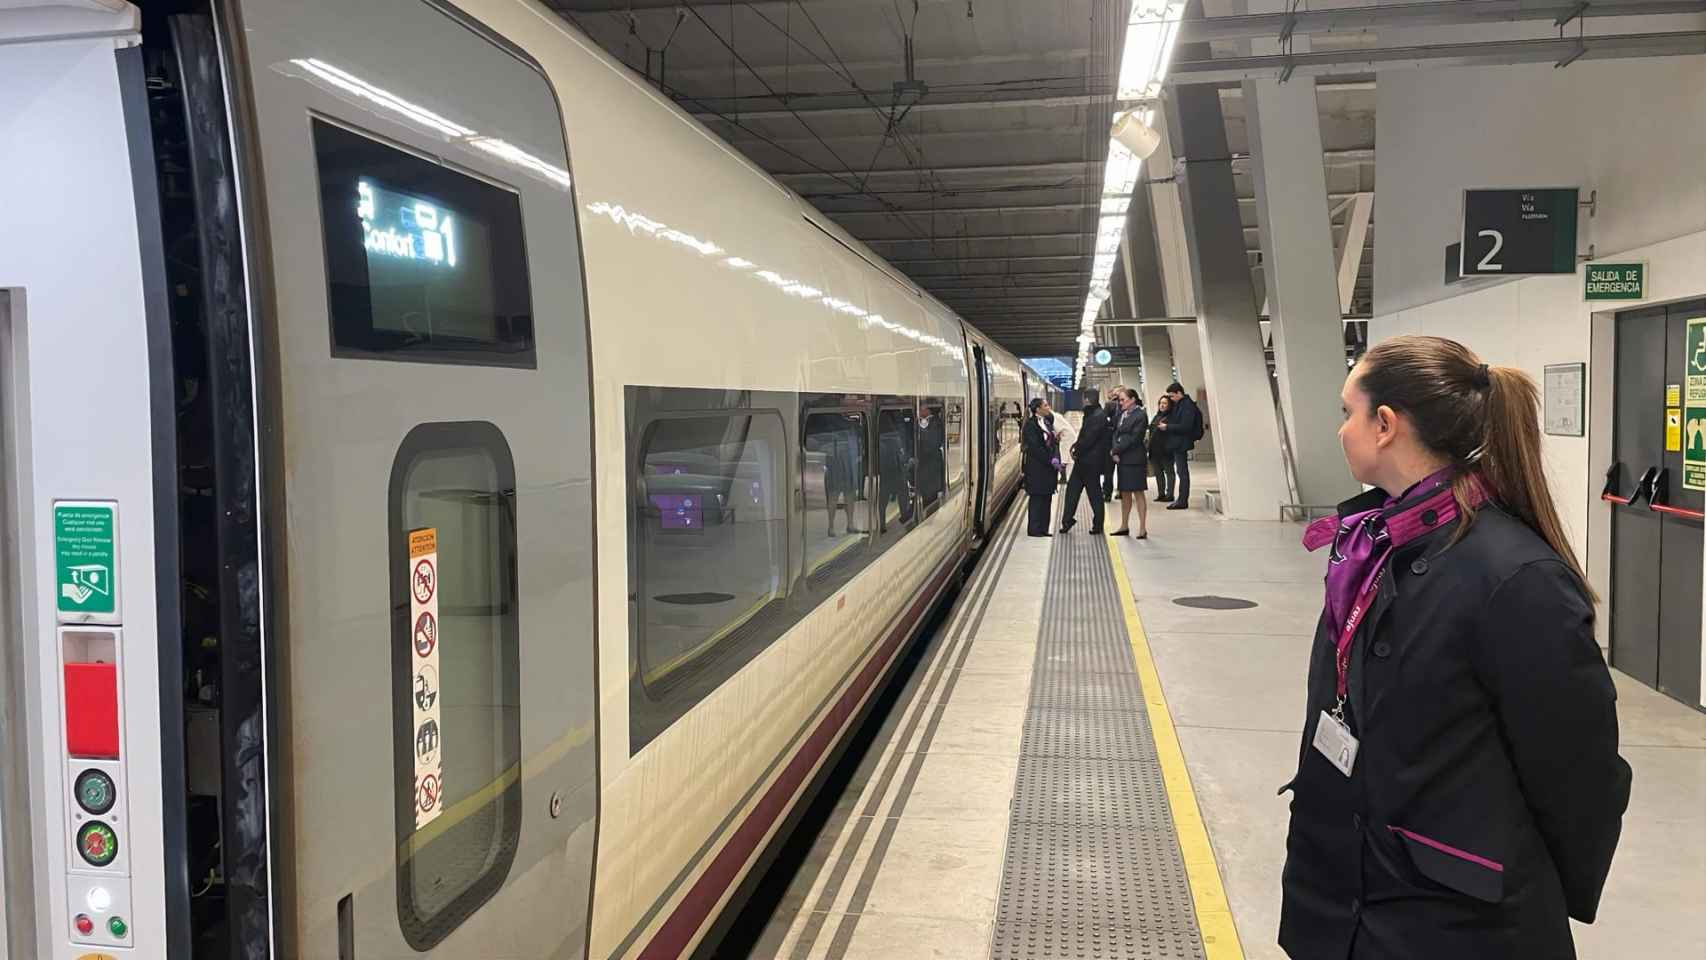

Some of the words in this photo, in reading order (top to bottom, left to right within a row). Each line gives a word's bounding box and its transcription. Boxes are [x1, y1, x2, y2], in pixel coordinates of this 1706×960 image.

[1477, 229, 1504, 271] 2
[1591, 271, 1620, 282] SALIDA
[1625, 270, 1638, 281] DE
[1587, 282, 1640, 293] EMERGENCIA
[1345, 606, 1361, 632] renfe
